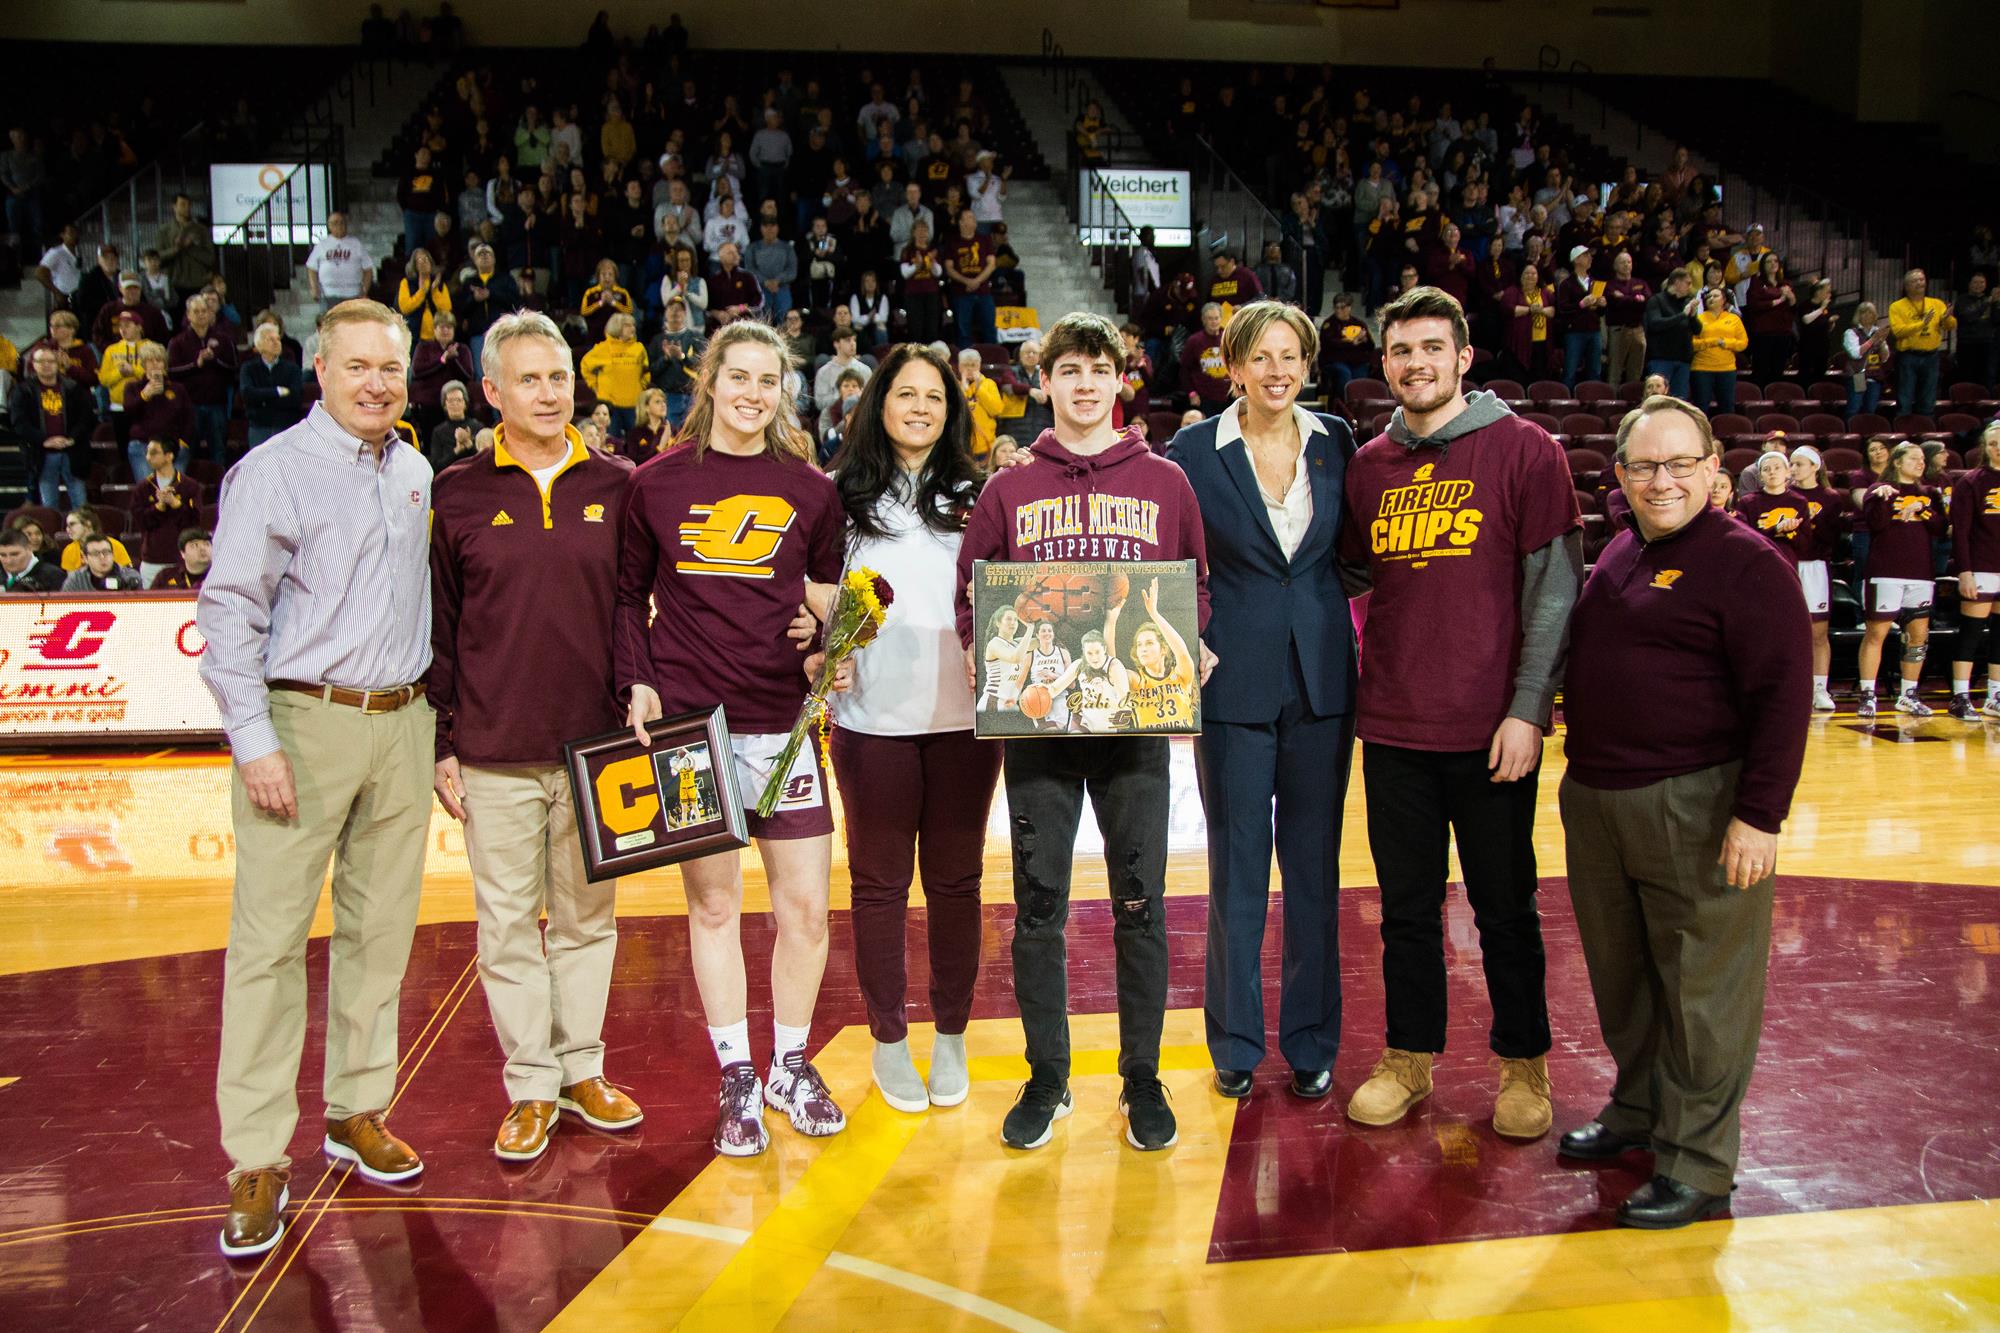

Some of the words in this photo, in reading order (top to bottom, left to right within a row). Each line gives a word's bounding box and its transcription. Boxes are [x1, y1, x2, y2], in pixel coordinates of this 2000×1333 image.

[1091, 175, 1178, 193] Weichert
[1378, 483, 1436, 517] FIRE
[1433, 480, 1475, 509] UP
[679, 494, 797, 566] C
[1016, 494, 1083, 547] CENTRAL
[1087, 493, 1160, 546] MICHIGAN
[1371, 509, 1483, 554] CHIPS
[985, 564, 1042, 576] CENTRAL
[1047, 562, 1109, 576] MICHIGAN
[1111, 562, 1188, 576] UNIVERSITY
[1034, 538, 1142, 562] CHIPPEWAS
[30, 611, 117, 660] C
[1156, 699, 1177, 718] 33
[596, 754, 660, 835] C
